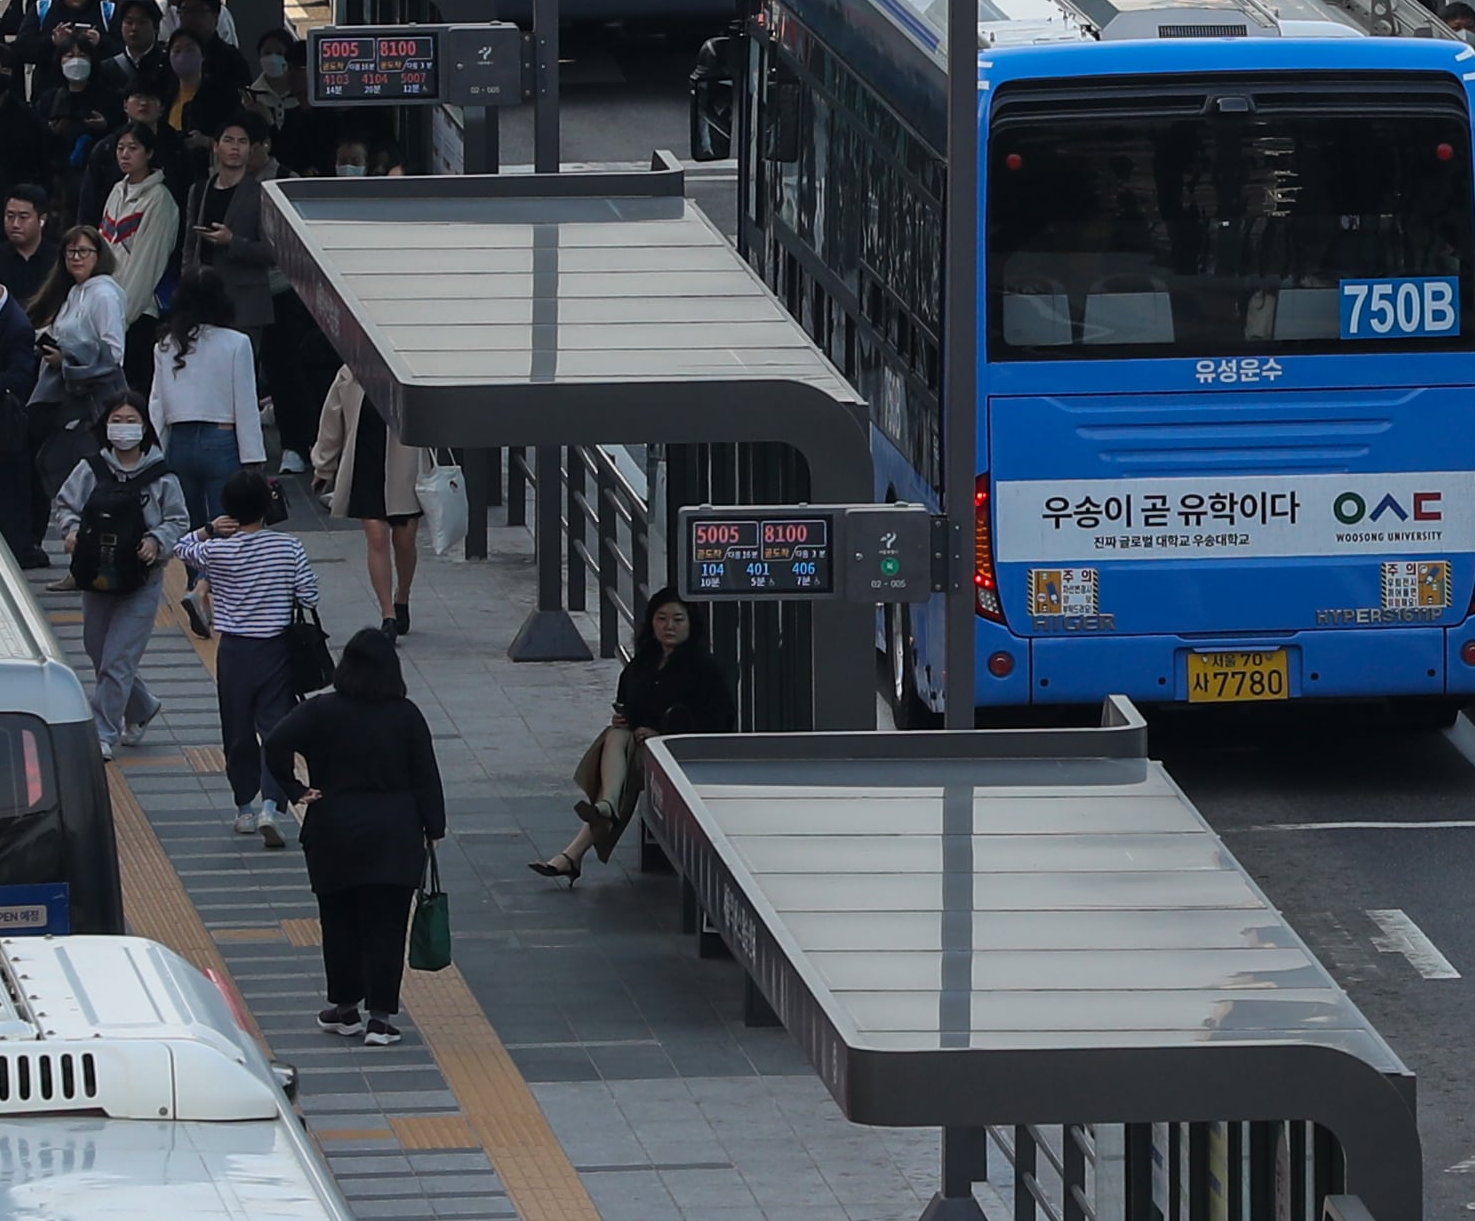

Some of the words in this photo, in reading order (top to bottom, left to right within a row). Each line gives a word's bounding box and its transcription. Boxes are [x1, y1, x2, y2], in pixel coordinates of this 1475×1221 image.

[322, 42, 359, 57] 5005
[380, 41, 416, 56] 8100
[323, 75, 350, 85] 4103
[361, 74, 388, 84] 4104
[400, 73, 426, 83] 5007
[1343, 281, 1456, 334] 750B
[1195, 358, 1283, 383] 유성운수
[1042, 493, 1132, 530] 우송이
[1139, 495, 1171, 528] 곧
[1177, 491, 1301, 526] 유학이다
[697, 525, 740, 544] 5005
[765, 524, 807, 543] 8100
[1336, 533, 1384, 544] WOOSONG
[1387, 531, 1443, 542] UNIVERSITY
[1093, 535, 1117, 549] 진짜
[1119, 535, 1153, 549] 글로벌
[1156, 534, 1190, 548] 대학교
[1192, 533, 1250, 547] 우송대학교
[701, 563, 725, 576] 104
[746, 563, 770, 576] 401
[792, 562, 816, 575] 406
[700, 578, 721, 588] 10분
[751, 578, 766, 587] 5분
[797, 577, 811, 586] 7분
[1212, 654, 1236, 668] 서울
[1241, 653, 1263, 667] 70
[20, 910, 40, 922] 예정
